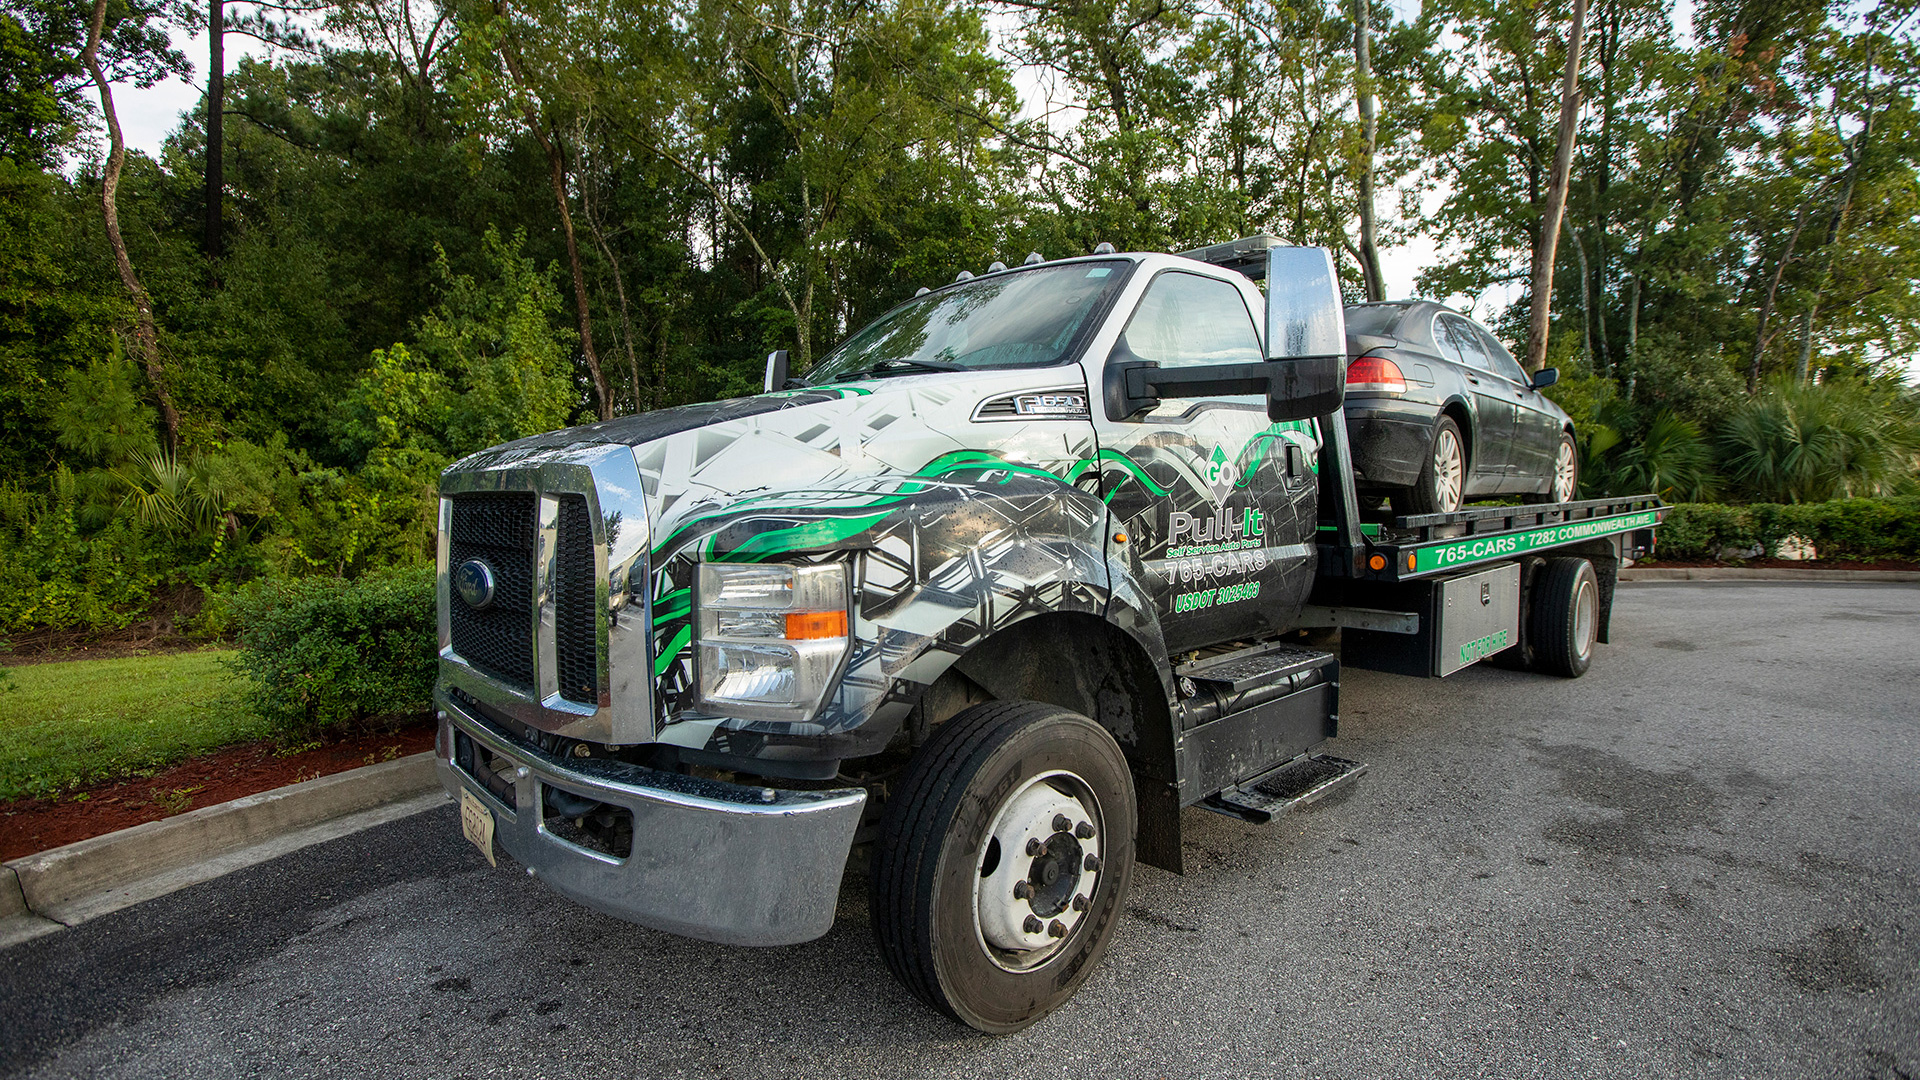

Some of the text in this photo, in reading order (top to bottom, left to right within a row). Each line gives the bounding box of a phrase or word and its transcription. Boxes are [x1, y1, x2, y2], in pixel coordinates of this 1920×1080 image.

[1206, 461, 1234, 487] GO
[1167, 507, 1264, 546] Pull-It
[1435, 536, 1516, 565] 765-CARS
[1528, 530, 1556, 547] 7282
[1558, 517, 1635, 540] COMMONWEALTH
[1166, 538, 1262, 558] Self Service Auto Parts
[459, 567, 479, 597] Ford
[1164, 550, 1267, 585] 765-CARS
[1175, 581, 1260, 614] USDOT 3025483
[1459, 628, 1508, 665] NOT FOR HIRE
